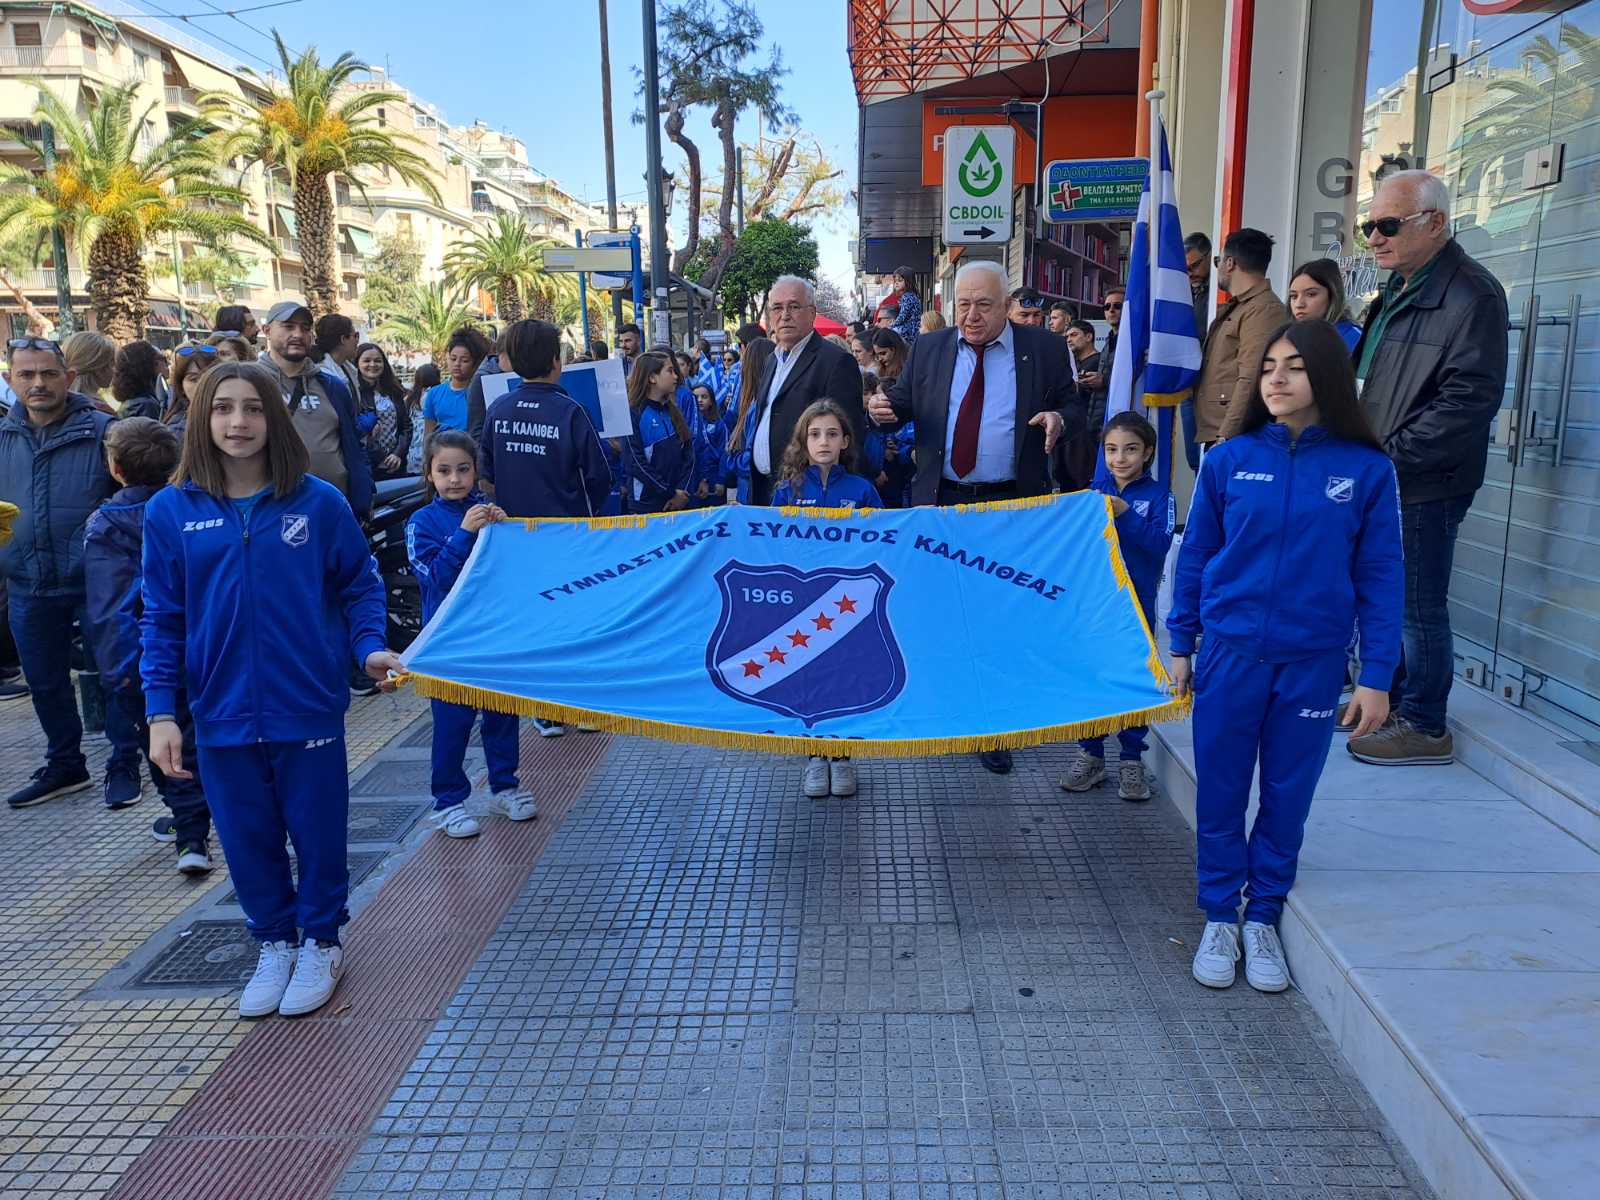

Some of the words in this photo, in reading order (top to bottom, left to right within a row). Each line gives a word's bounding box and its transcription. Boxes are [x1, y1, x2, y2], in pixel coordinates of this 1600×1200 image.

[1115, 183, 1143, 194] ΧΡΗΣΤΟ
[949, 205, 1004, 220] CBDOIL
[512, 421, 560, 440] ΚΑΛΛΙΘΕΑ
[505, 442, 546, 455] ΣΤΙΒΟΣ
[538, 521, 732, 601] ΓΥΜΝΑΣΤΙΚΟΣ
[747, 521, 899, 545] ΣΥΛΛΟΓΟΣ
[913, 534, 1066, 601] ΚΑΛΛΙΘΕΑΣ
[741, 587, 794, 605] 1966
